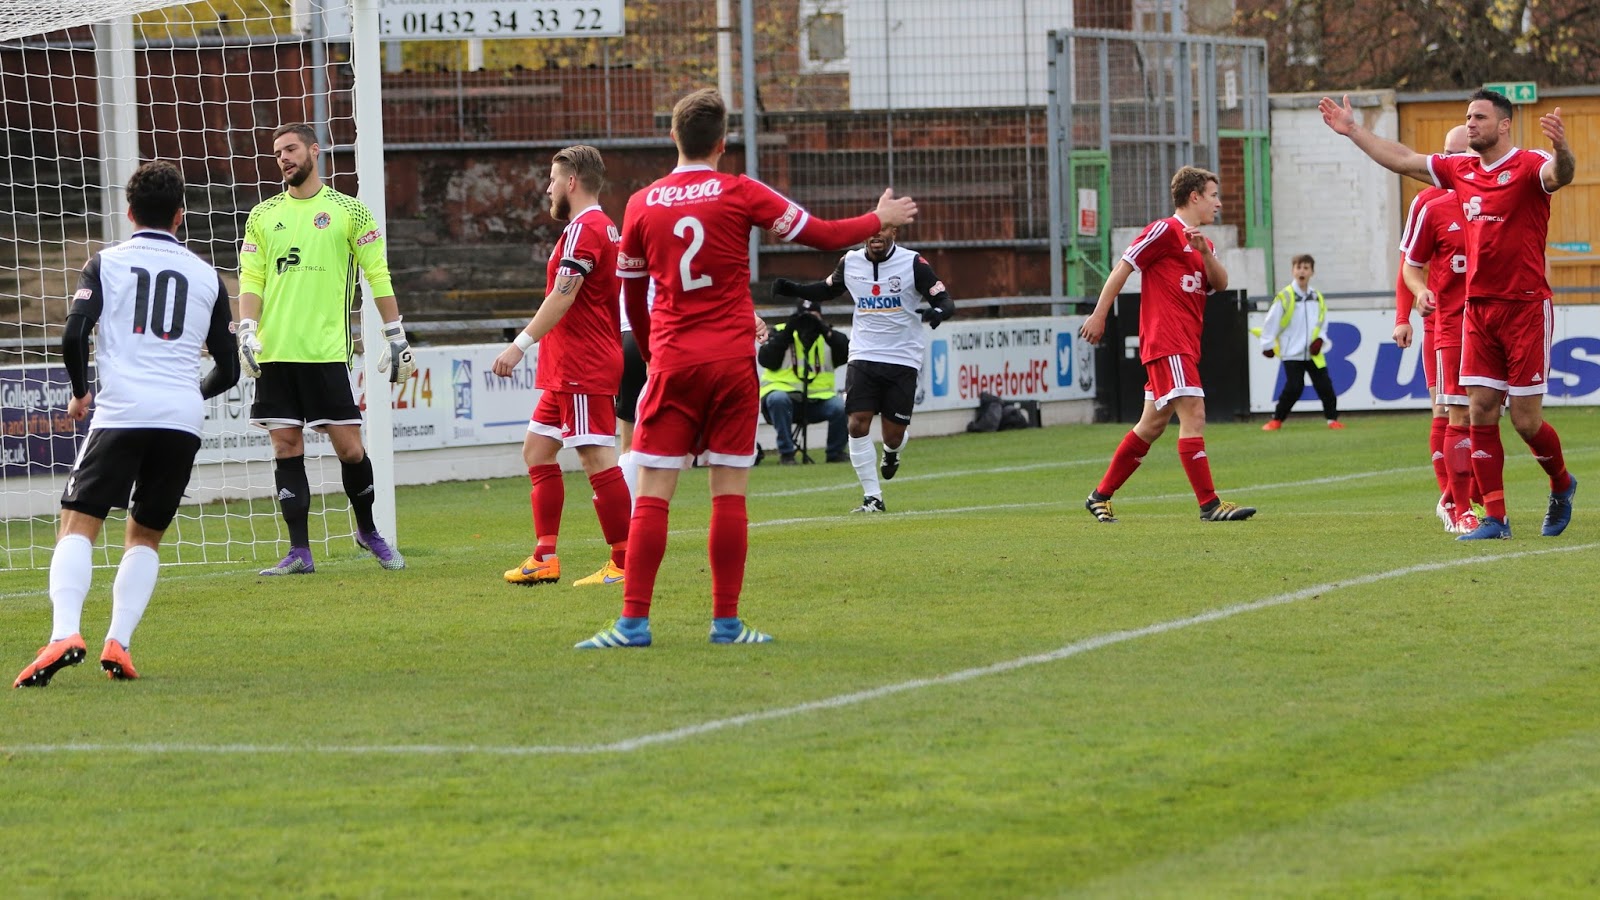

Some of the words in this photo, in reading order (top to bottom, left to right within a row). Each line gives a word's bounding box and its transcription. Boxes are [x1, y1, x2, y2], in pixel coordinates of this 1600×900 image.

[402, 11, 475, 33] 01432
[488, 11, 518, 32] 34
[530, 9, 561, 32] 33
[574, 8, 603, 31] 22
[646, 178, 722, 207] Clevera
[673, 216, 713, 291] 2
[130, 266, 189, 341] 10
[857, 296, 903, 310] JEWSON
[952, 334, 981, 350] FOLLOW
[985, 332, 994, 348] US
[998, 331, 1009, 347] ON
[1012, 329, 1040, 347] TWITTER
[1044, 328, 1052, 345] AT
[958, 359, 1048, 399] @HerefordFC
[2, 383, 41, 413] College
[8, 414, 25, 435] and
